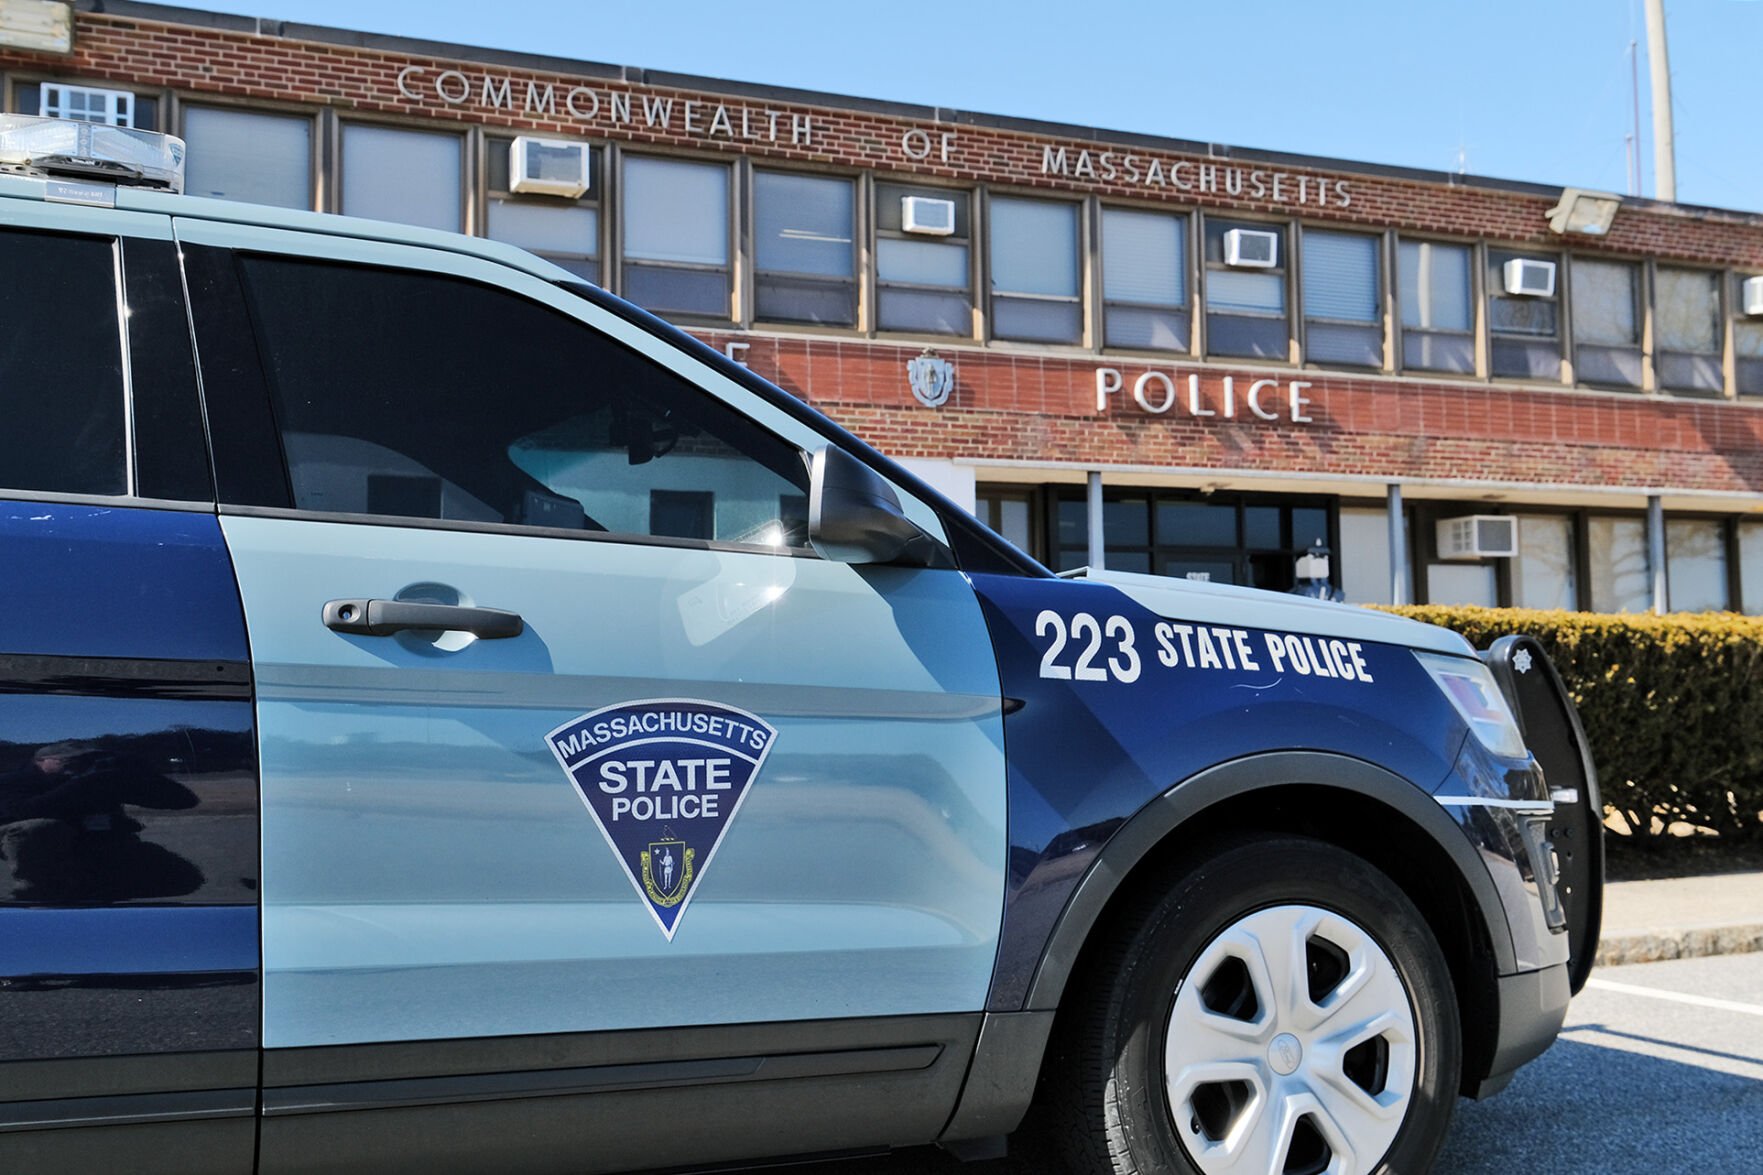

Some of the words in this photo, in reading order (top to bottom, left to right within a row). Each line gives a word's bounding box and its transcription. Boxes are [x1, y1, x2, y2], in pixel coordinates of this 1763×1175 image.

[397, 66, 812, 145] COMMONWEALTH
[902, 129, 957, 163] OF
[1041, 145, 1352, 207] MASSACHUSETTS
[1097, 368, 1313, 422] POLICE
[1035, 609, 1141, 684] 223
[1154, 622, 1260, 671] STATE
[1263, 633, 1374, 683] POLICE
[556, 711, 767, 759] MASSACHUSETTS
[598, 758, 732, 794] STATE
[612, 794, 719, 821] POLICE
